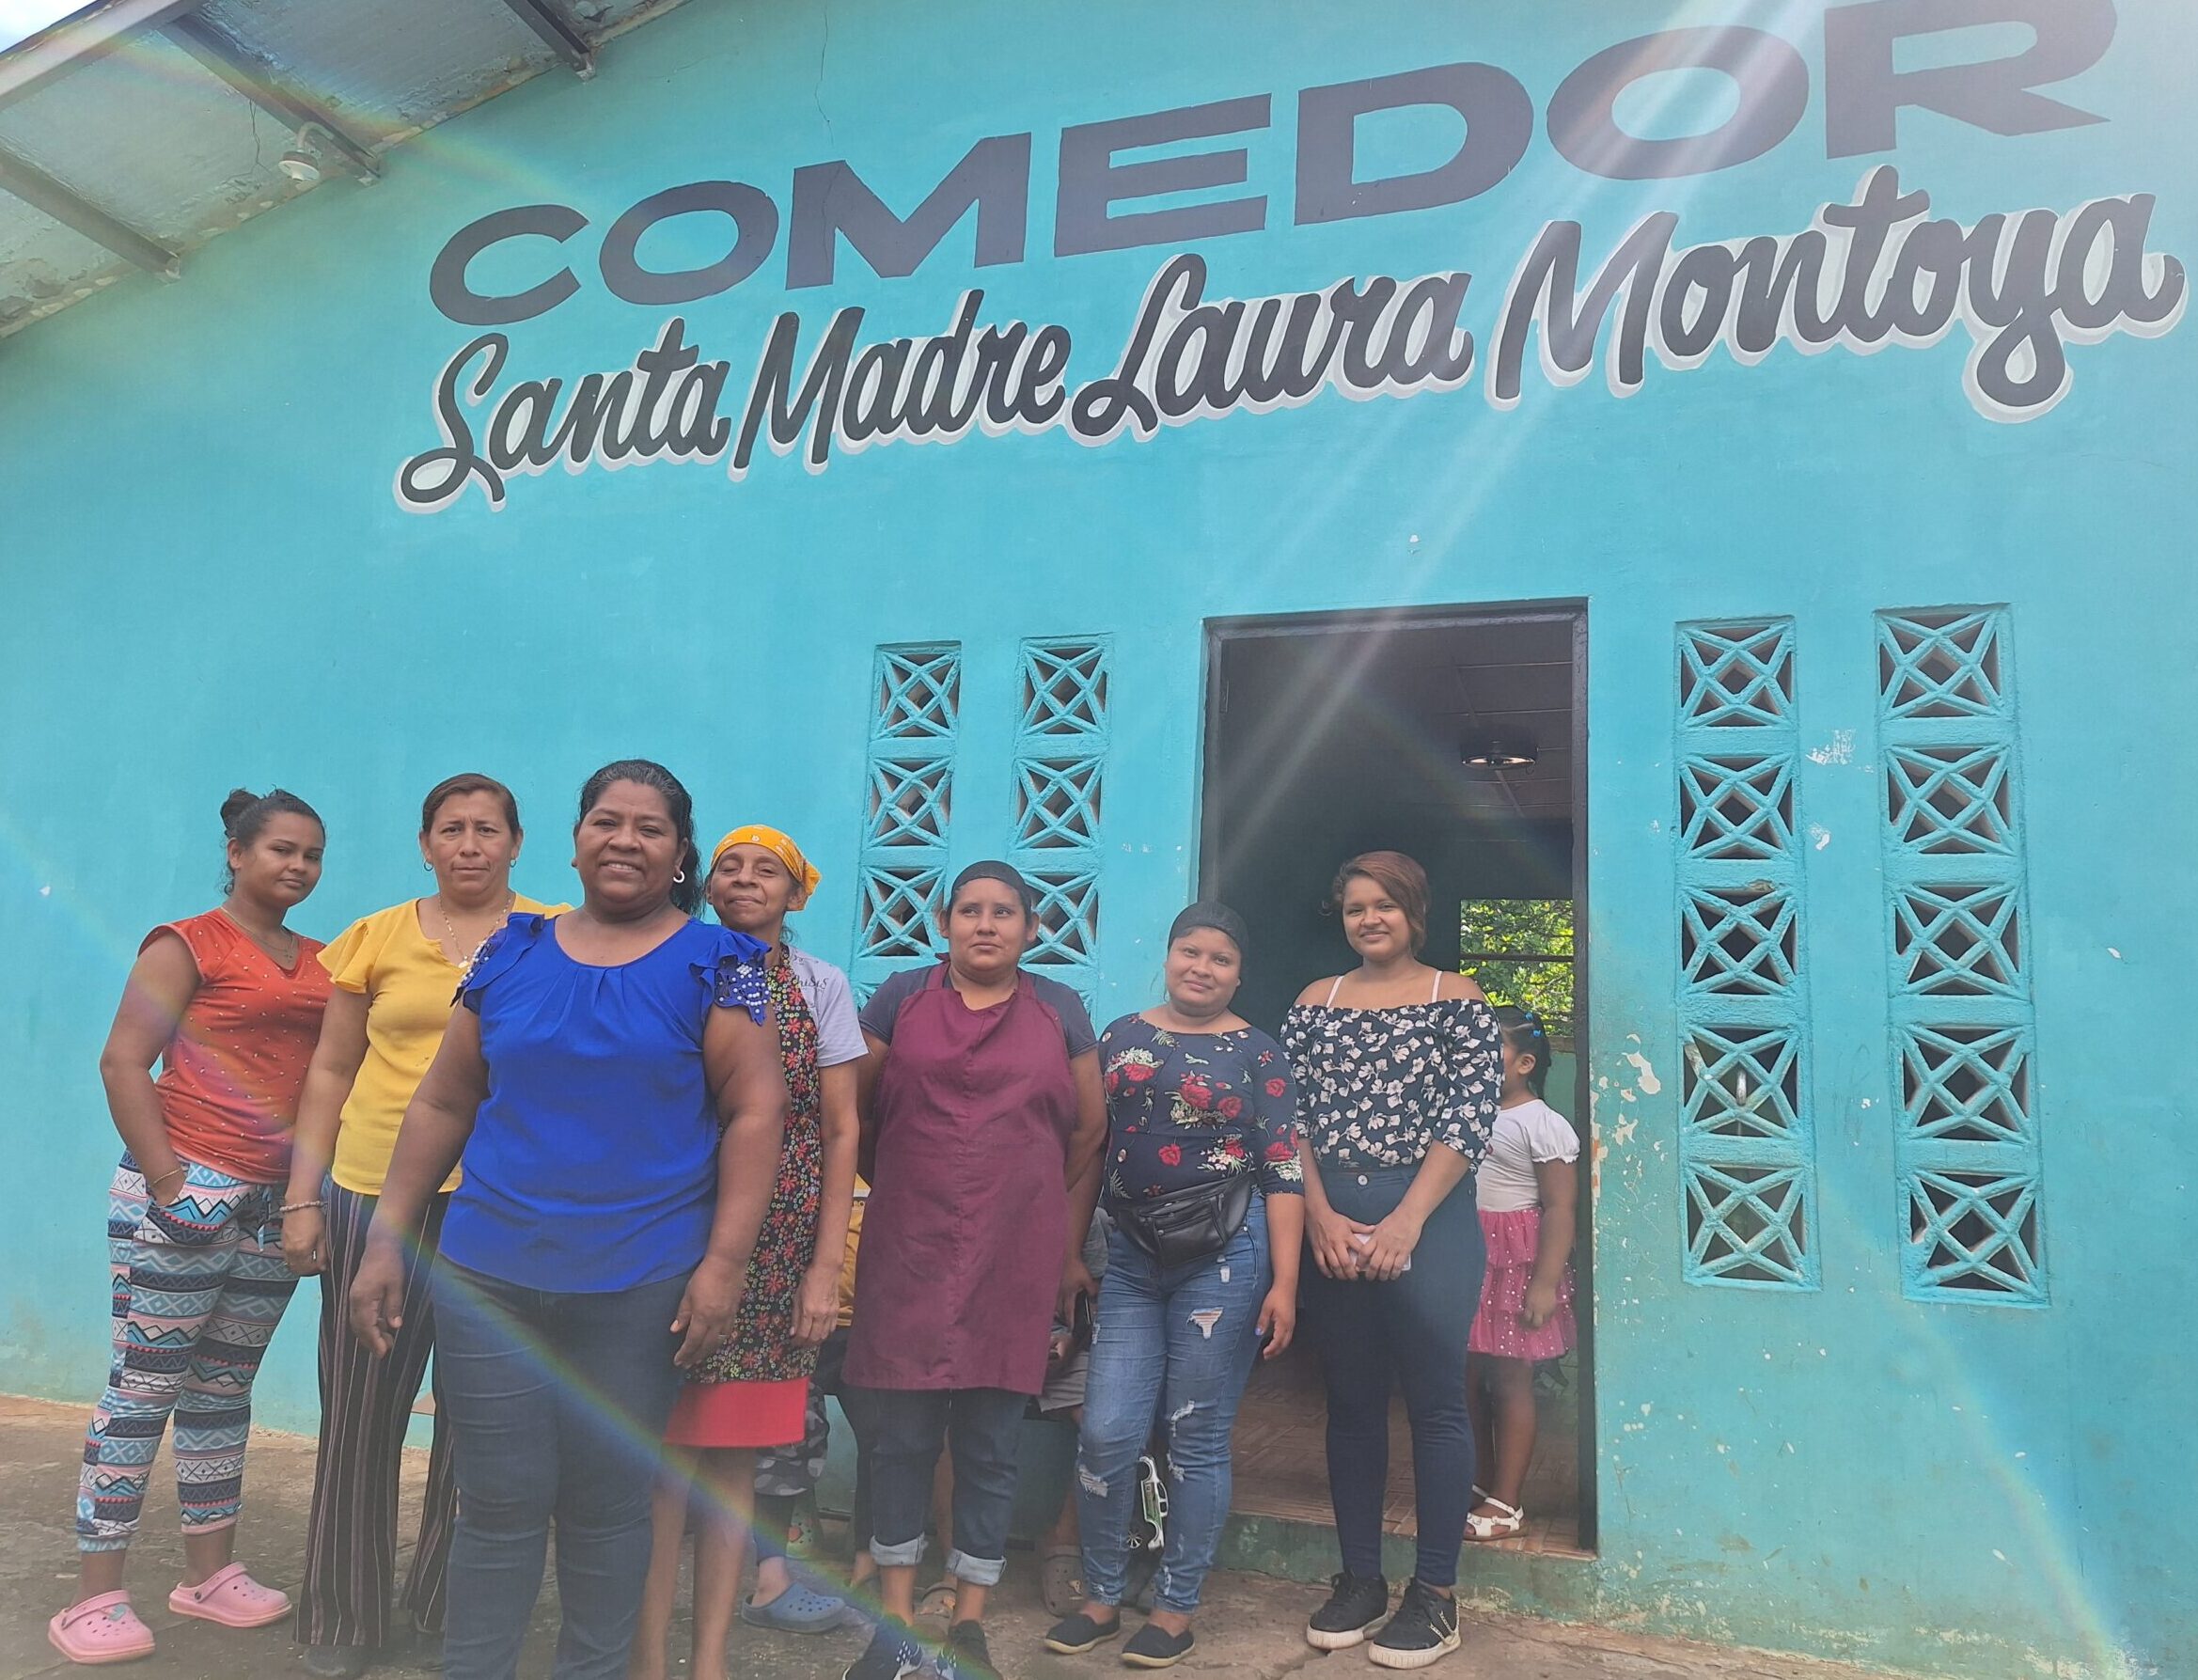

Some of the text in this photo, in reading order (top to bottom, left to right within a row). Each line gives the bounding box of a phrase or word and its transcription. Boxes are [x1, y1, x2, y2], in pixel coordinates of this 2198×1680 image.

[429, 0, 2118, 326] COMEDOR
[395, 164, 2188, 510] Santa Madre Laura Montoya
